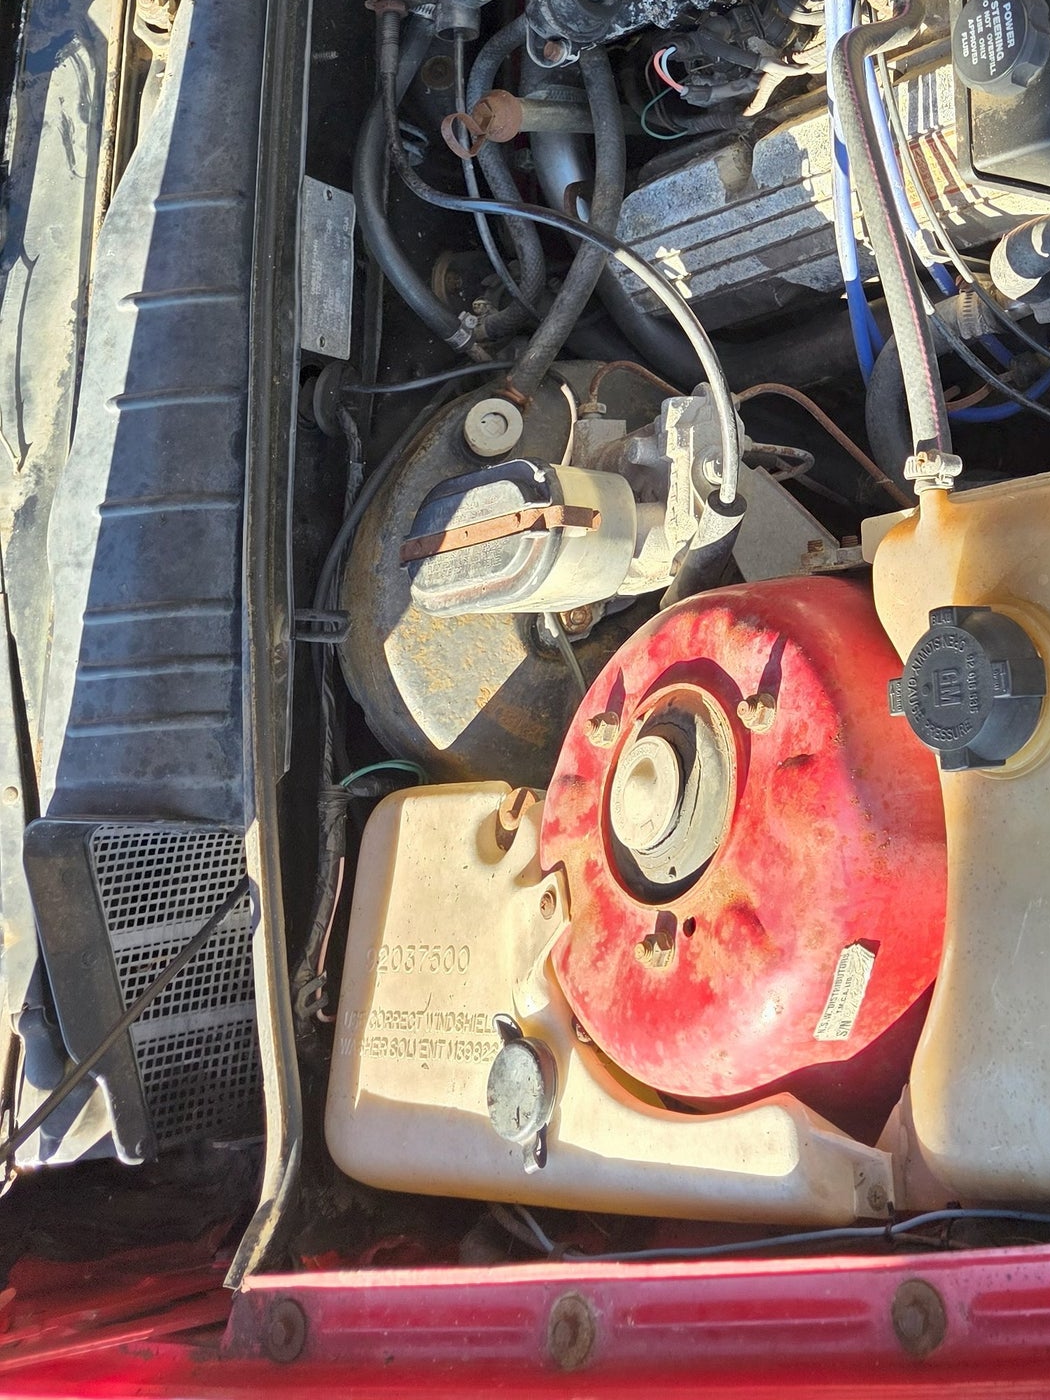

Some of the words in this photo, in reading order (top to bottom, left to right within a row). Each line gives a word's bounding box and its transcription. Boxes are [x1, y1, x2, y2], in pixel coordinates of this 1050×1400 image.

[975, 15, 983, 33] USE
[983, 10, 991, 28] NOT
[990, 0, 1004, 61] STEERING
[1002, 1, 1015, 48] POWER
[960, 31, 969, 57] FLUID
[967, 18, 978, 64] APPROVED
[978, 37, 986, 59] ONLY
[986, 33, 996, 75] OVERFILL
[939, 668, 960, 705] GM
[369, 1008, 424, 1031] CORRECT
[836, 1020, 852, 1037] S/N
